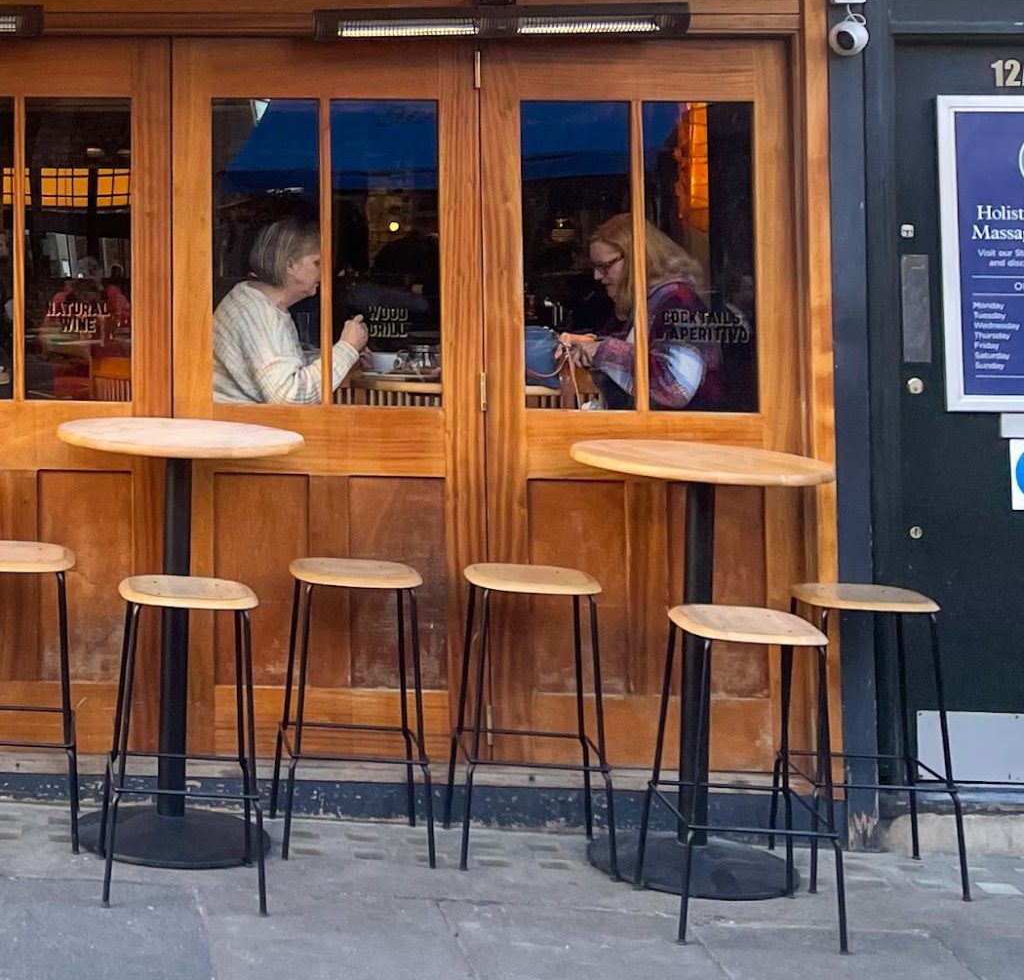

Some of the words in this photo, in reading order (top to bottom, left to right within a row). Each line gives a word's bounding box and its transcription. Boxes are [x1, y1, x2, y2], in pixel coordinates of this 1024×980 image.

[990, 59, 1024, 87] 12
[971, 224, 1024, 243] Massa
[977, 249, 996, 257] Visit
[988, 259, 1006, 267] and
[44, 301, 111, 317] NATURAL
[972, 301, 1005, 310] Monday
[367, 305, 409, 321] WOOD
[662, 308, 744, 327] COCKTAILS
[973, 311, 1007, 320] Tuesday
[60, 317, 97, 333] WINE
[973, 322, 1021, 331] Wednesday
[974, 331, 1011, 341] Thursday
[974, 341, 1000, 350] Friday
[974, 351, 1011, 360] Saturday
[975, 361, 1005, 371] Sunday
